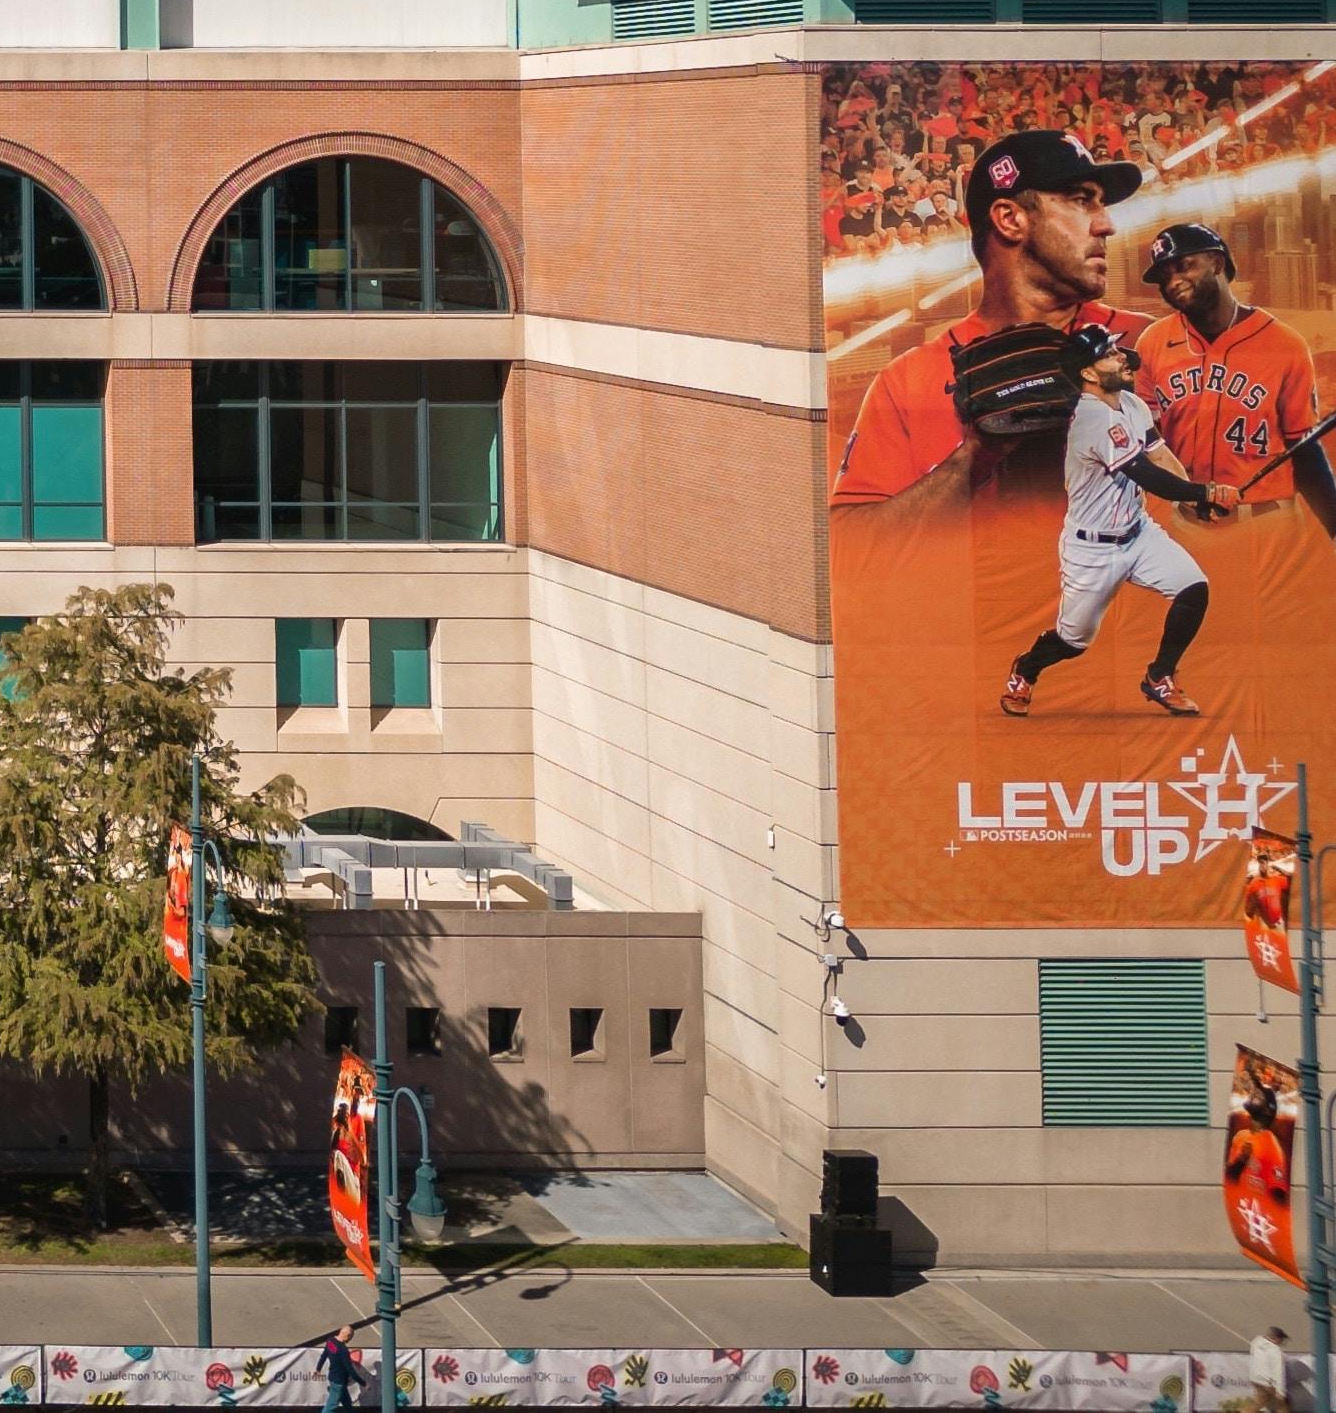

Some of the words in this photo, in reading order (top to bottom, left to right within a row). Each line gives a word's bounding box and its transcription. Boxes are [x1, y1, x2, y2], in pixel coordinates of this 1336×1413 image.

[1155, 362, 1268, 412] ASTROS
[1225, 417, 1270, 456] 44
[957, 781, 1189, 828] LEVEL
[1198, 773, 1268, 841] H
[980, 829, 1068, 842] POSTSEASON
[1101, 829, 1190, 876] UP
[99, 1371, 150, 1381] lululemon
[153, 1371, 171, 1381] 10K
[173, 1371, 194, 1382] Tour
[289, 1371, 327, 1382] lululem
[480, 1373, 531, 1384] lululemon
[533, 1372, 551, 1382] 10K
[554, 1374, 576, 1384] Tour
[671, 1374, 722, 1384] lululemon
[725, 1373, 742, 1383] 10K
[862, 1374, 911, 1385] lululemon
[914, 1373, 932, 1383] 10K
